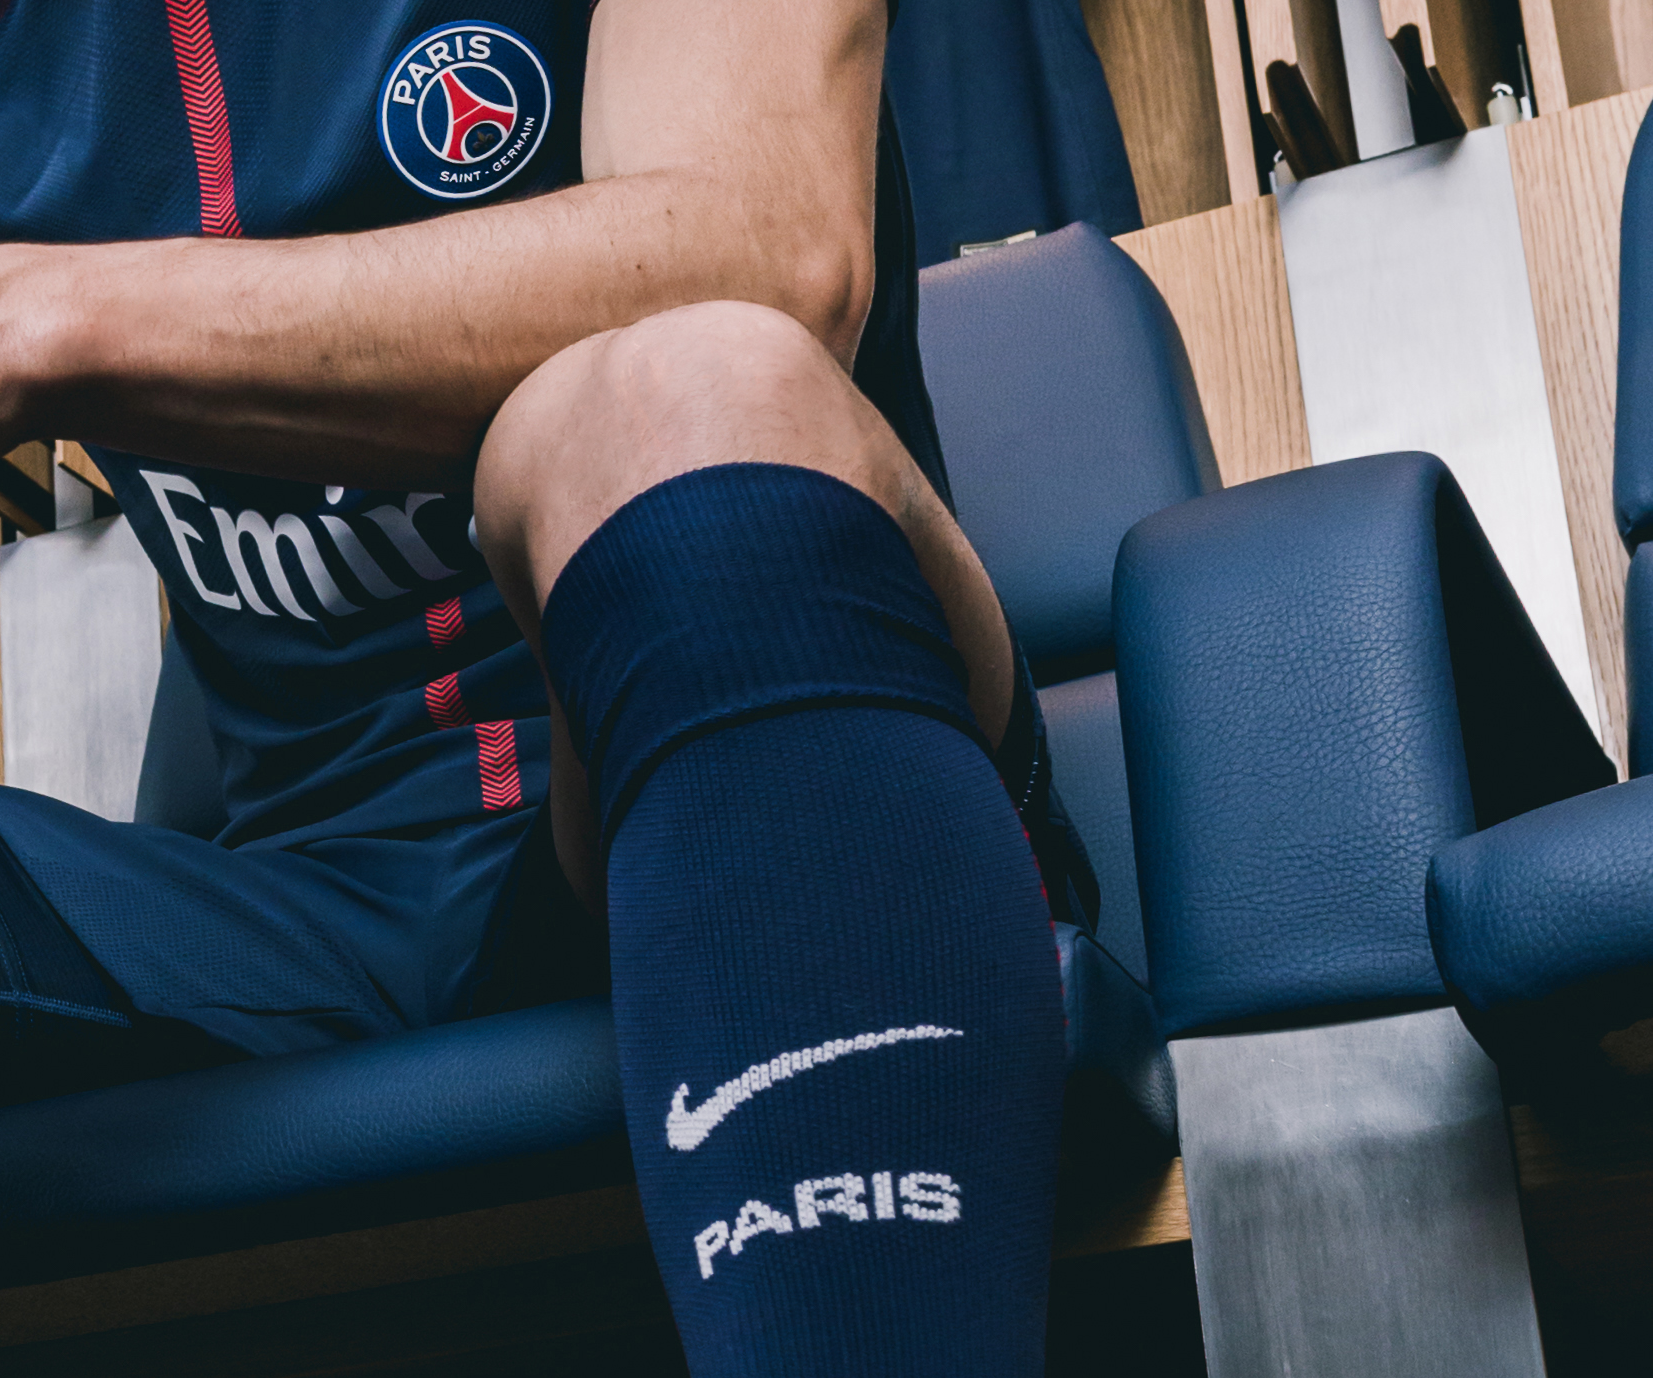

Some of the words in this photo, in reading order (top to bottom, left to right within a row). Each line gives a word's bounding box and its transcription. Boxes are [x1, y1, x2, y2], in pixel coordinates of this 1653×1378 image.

[392, 34, 492, 106] PARIS
[439, 170, 482, 184] SAINT
[492, 116, 536, 172] GERMAIN
[138, 469, 484, 622] Emir
[693, 1171, 962, 1280] PARIS
